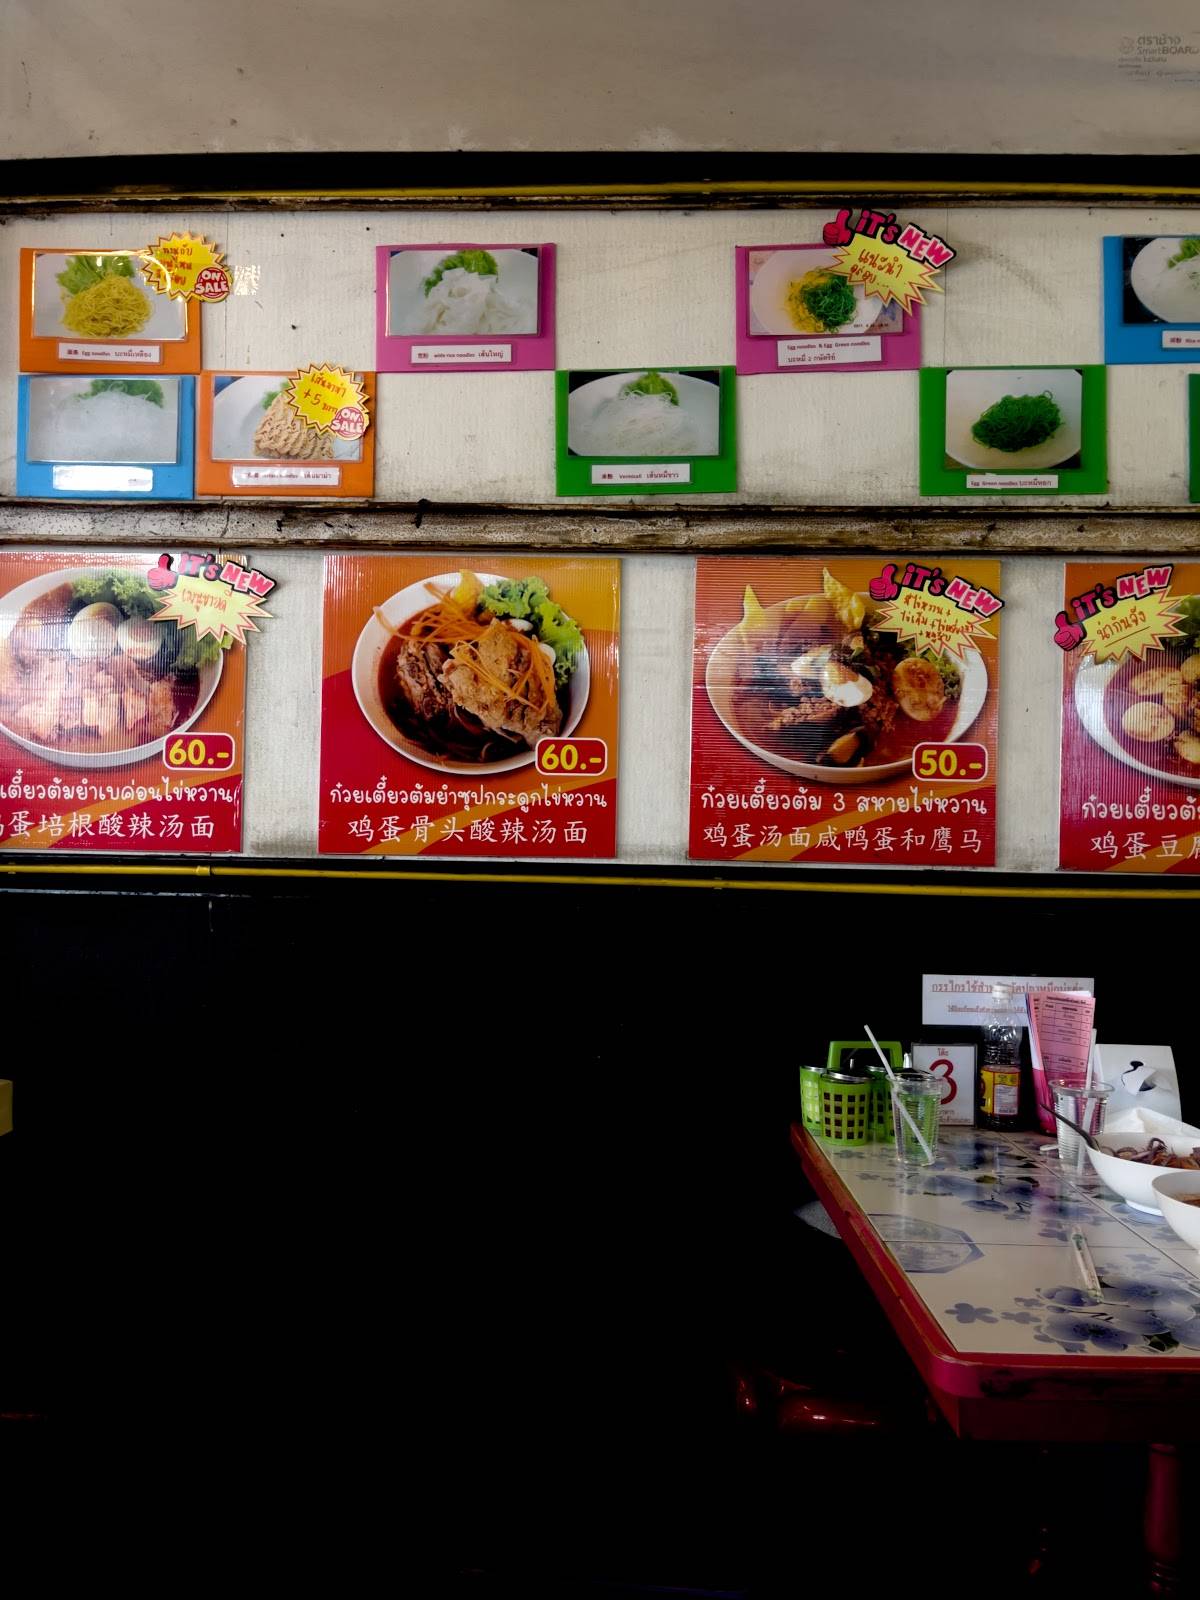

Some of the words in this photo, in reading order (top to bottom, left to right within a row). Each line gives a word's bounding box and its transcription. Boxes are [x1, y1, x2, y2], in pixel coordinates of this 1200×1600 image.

[897, 223, 955, 268] NEW
[194, 280, 229, 294] SALE
[201, 270, 222, 281] ON
[330, 419, 364, 434] SALE
[340, 408, 361, 421] ON
[219, 561, 276, 597] NEW
[1117, 565, 1173, 599] NEW
[944, 576, 1003, 616] NEW
[168, 738, 230, 766] 60.-
[540, 743, 602, 771] 60.-
[919, 749, 983, 777] 50.-
[832, 791, 846, 812] 3
[1081, 786, 1200, 821] ก๋วยเตี๋ยวต้
[0, 810, 215, 839] 蛋培根酸辣汤面
[347, 814, 588, 845] 鸡蛋骨头酸辣汤面
[928, 1058, 958, 1105] 3
